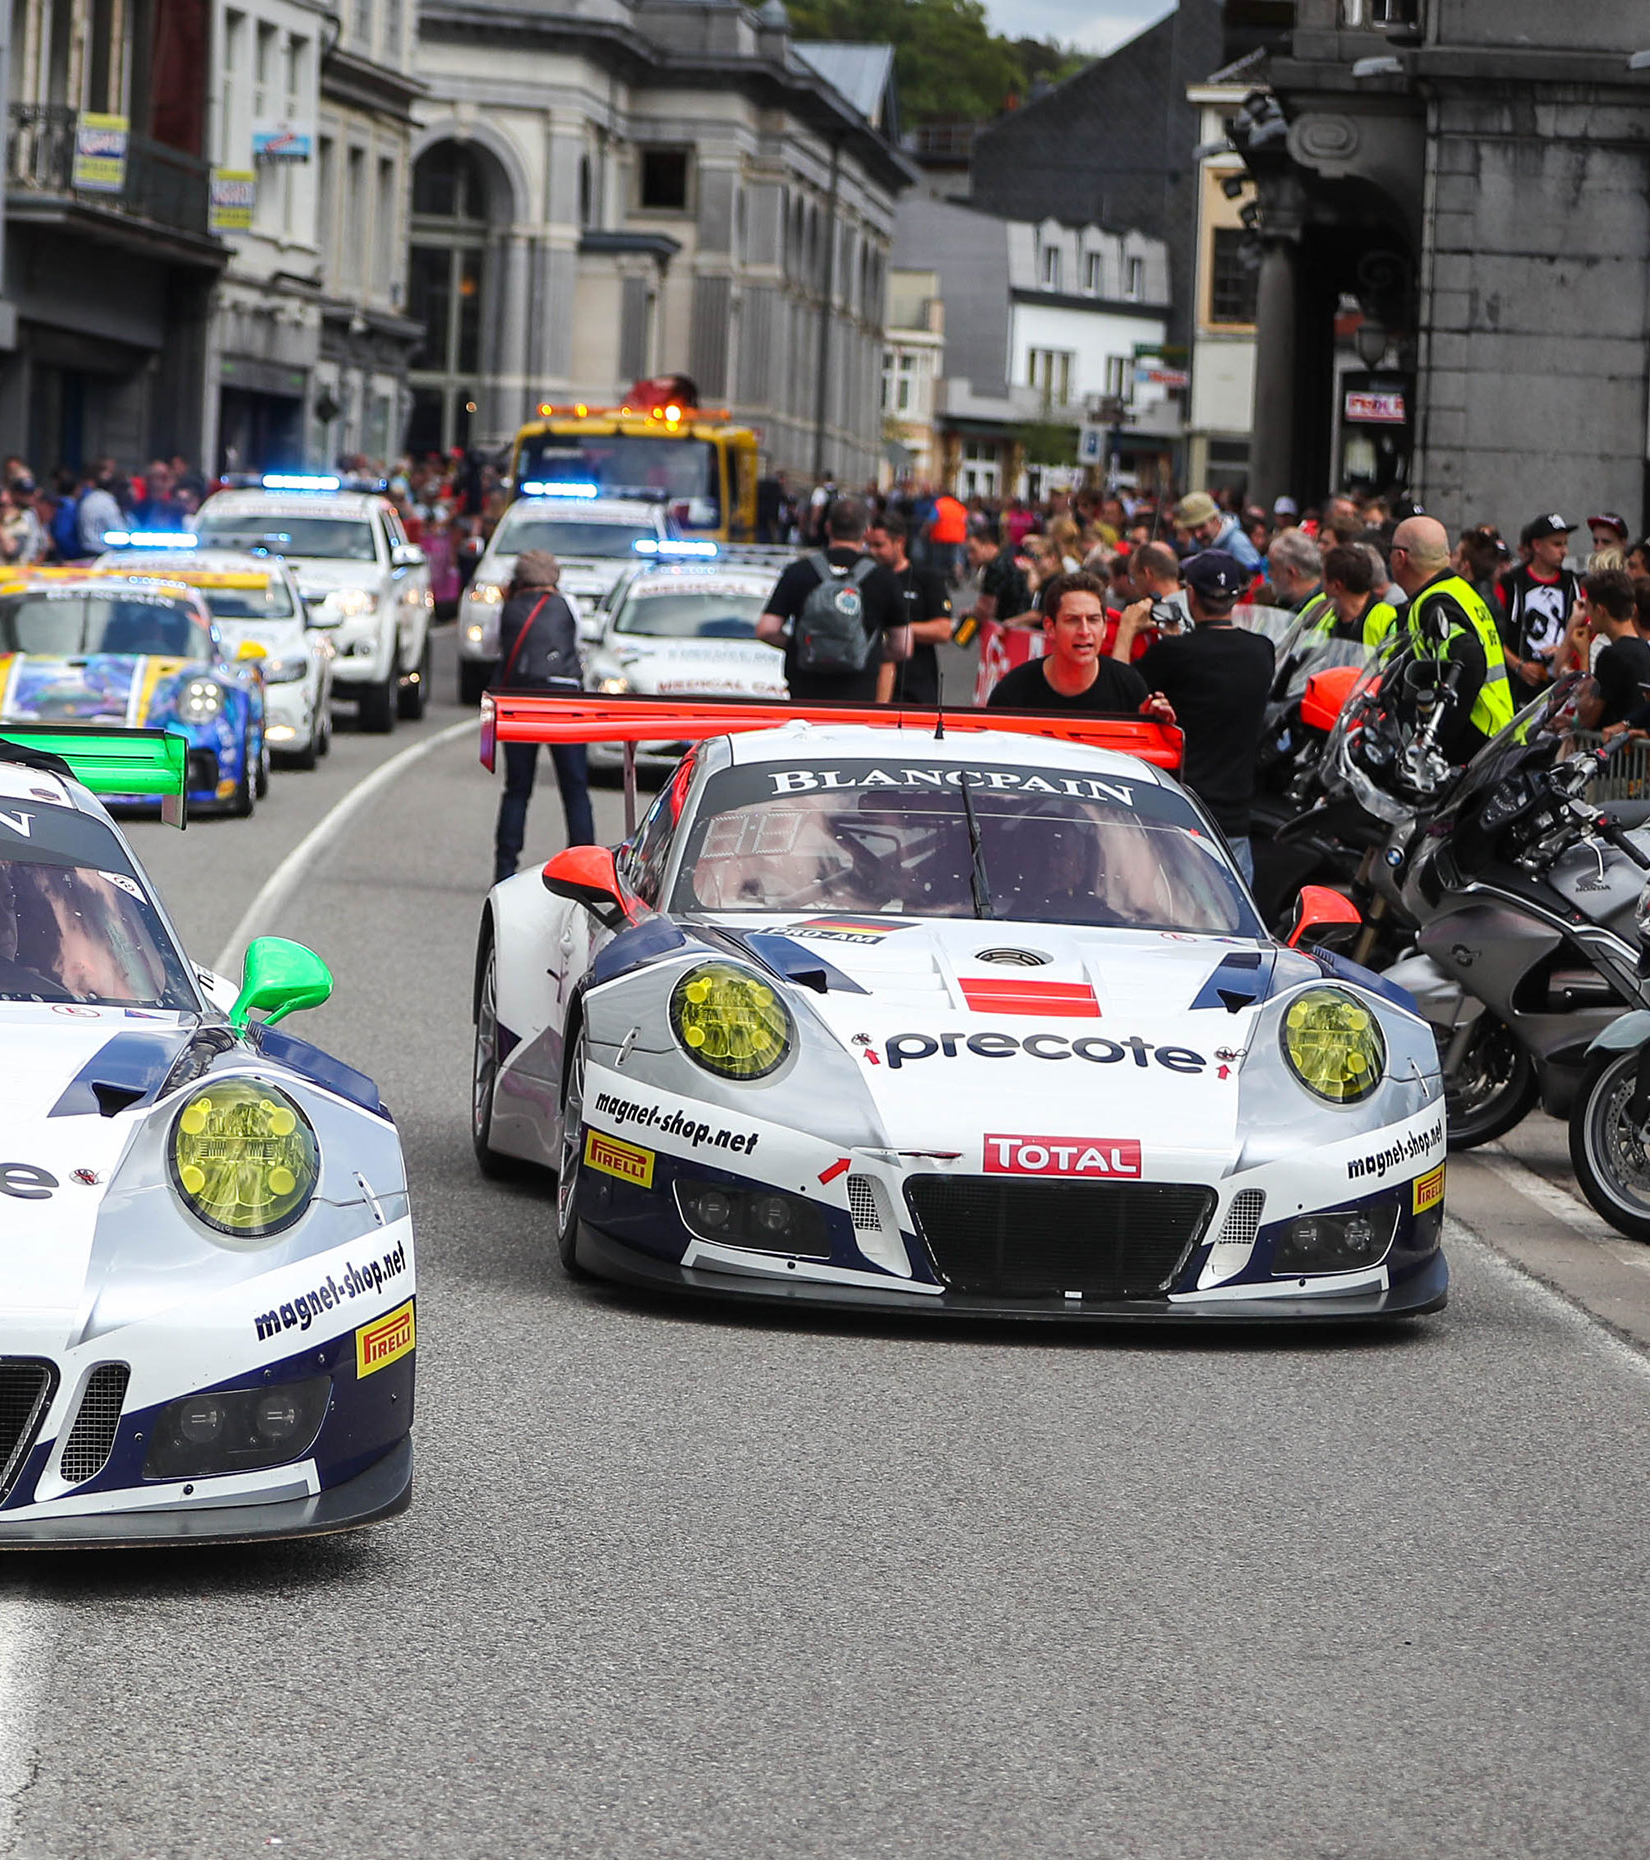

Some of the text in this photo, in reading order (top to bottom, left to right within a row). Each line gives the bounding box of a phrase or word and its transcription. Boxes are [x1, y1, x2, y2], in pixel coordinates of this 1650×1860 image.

[767, 768, 1134, 807] BLANCPAIN
[768, 927, 877, 944] PRO-AM
[885, 1032, 1207, 1074] precote
[595, 1092, 759, 1156] magnet-shop.net
[591, 1138, 647, 1179] PIRELLI
[988, 1138, 1137, 1173] TOTAL
[1347, 1118, 1443, 1180] magnet-shop.net
[254, 1240, 407, 1341] magnet-shop.net
[363, 1312, 411, 1365] PIRELLI
